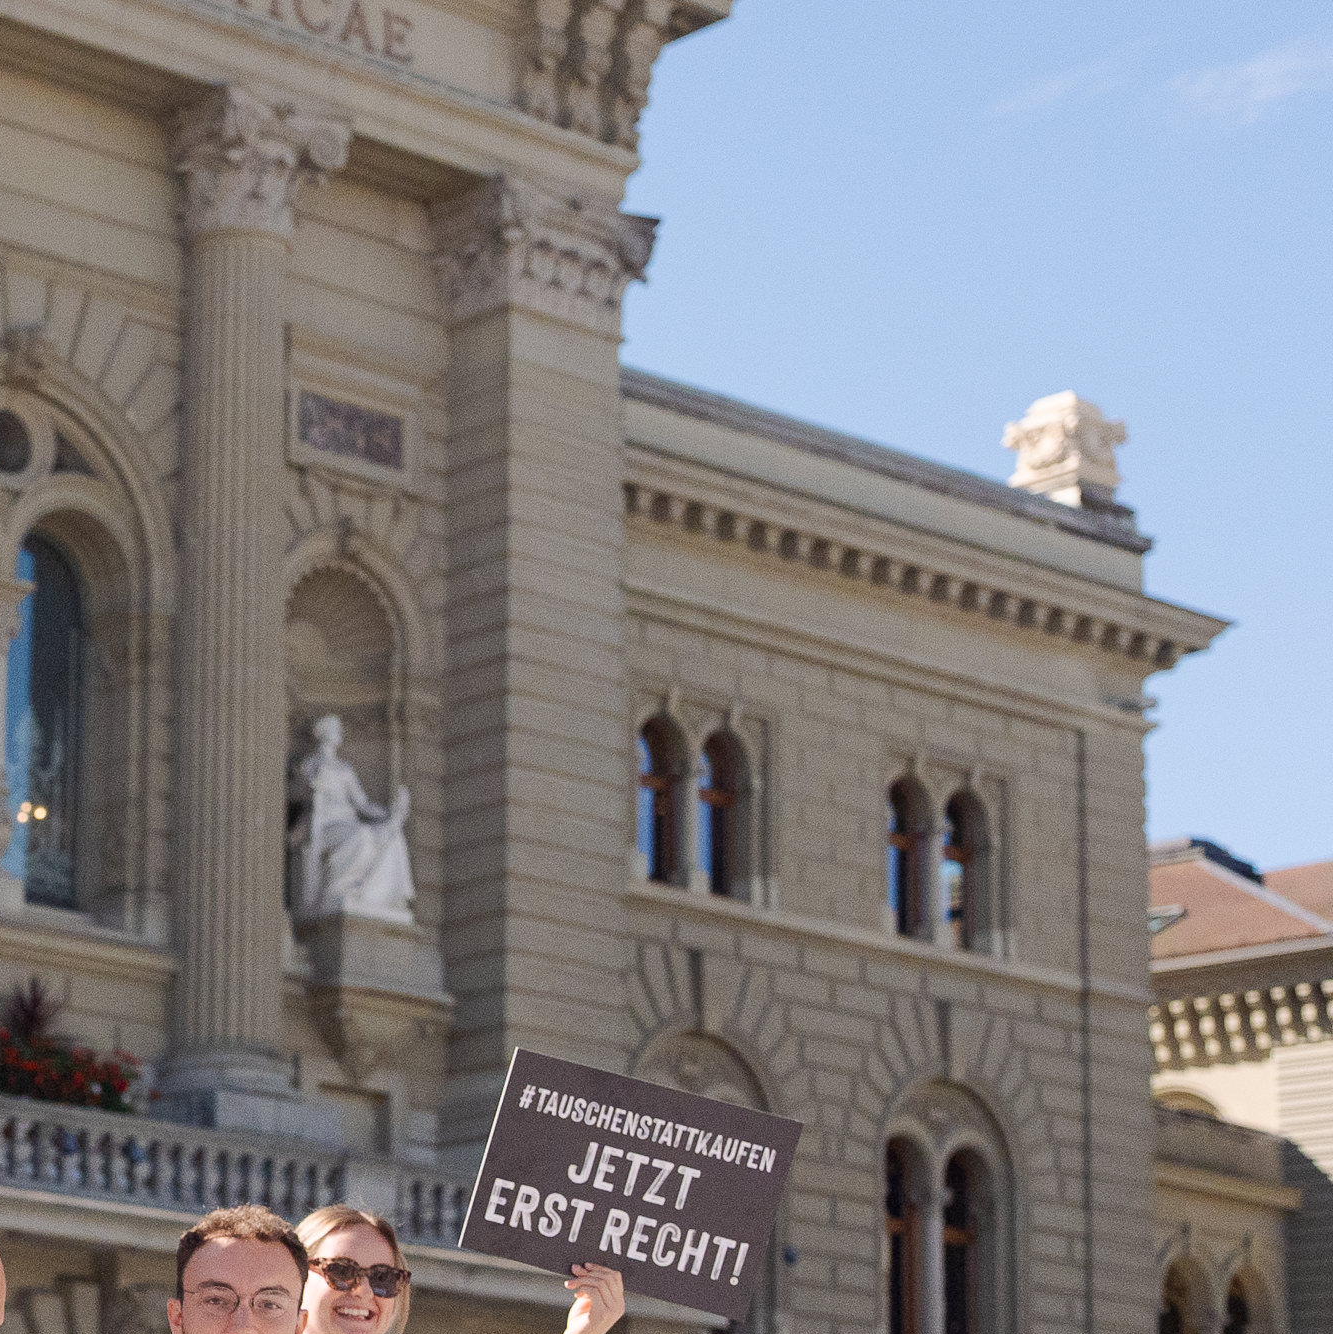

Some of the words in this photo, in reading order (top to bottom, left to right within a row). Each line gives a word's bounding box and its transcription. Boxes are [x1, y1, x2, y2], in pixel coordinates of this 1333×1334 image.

[519, 1084, 776, 1173] #TAUSCHENSTATTKAUFEN
[568, 1141, 701, 1211] JETZT
[485, 1178, 594, 1243] ERST
[599, 1208, 750, 1286] RECHT!
